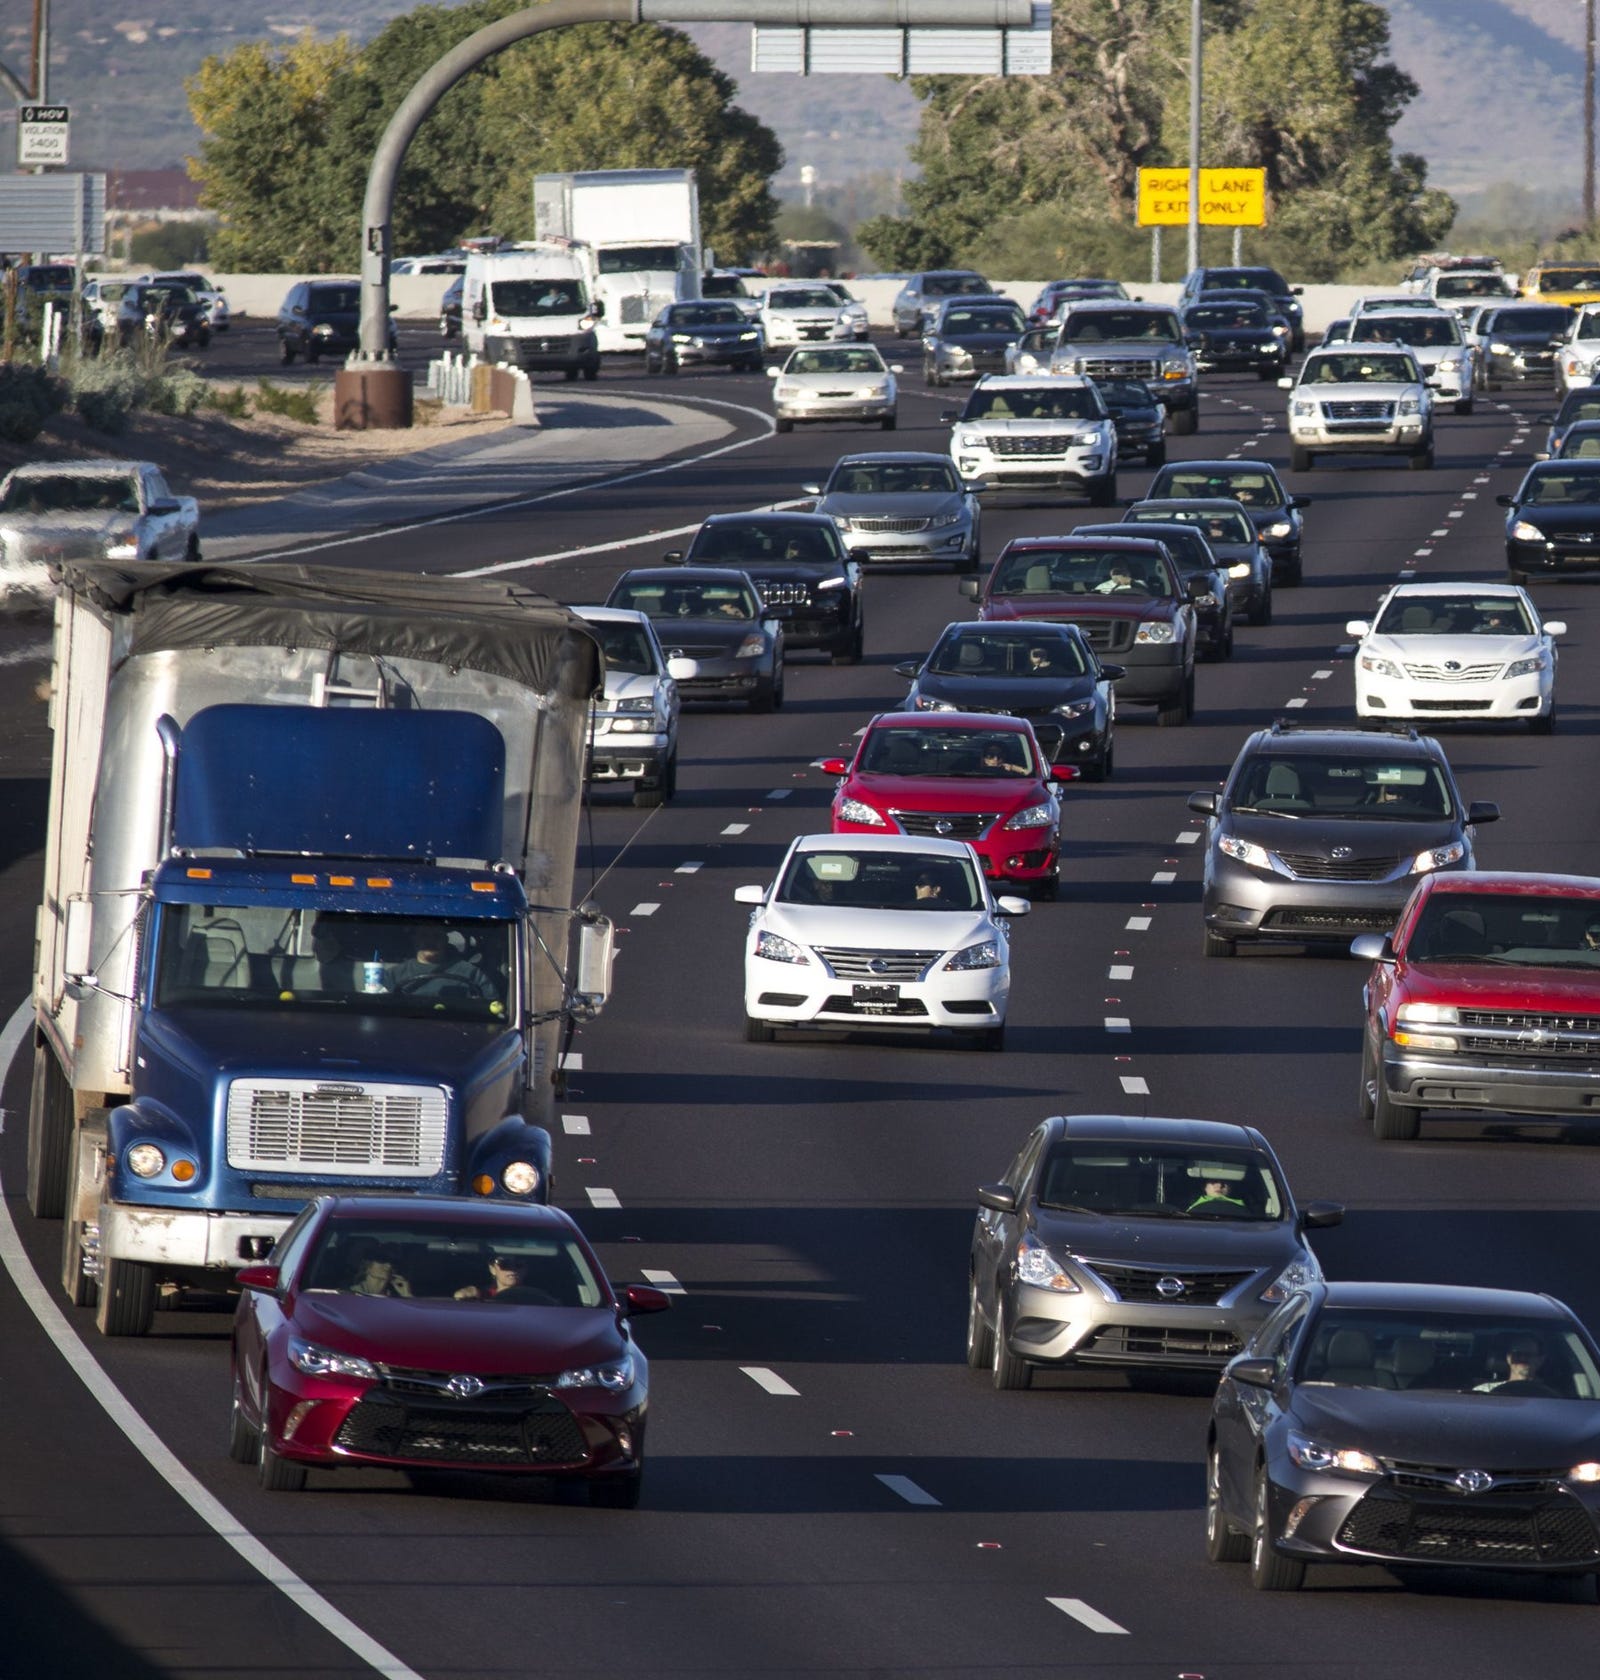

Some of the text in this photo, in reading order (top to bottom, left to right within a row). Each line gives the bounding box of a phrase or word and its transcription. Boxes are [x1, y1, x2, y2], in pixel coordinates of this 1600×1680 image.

[38, 109, 65, 119] HOV
[1148, 179, 1255, 192] RIGH LANE
[1202, 201, 1247, 214] ONLY
